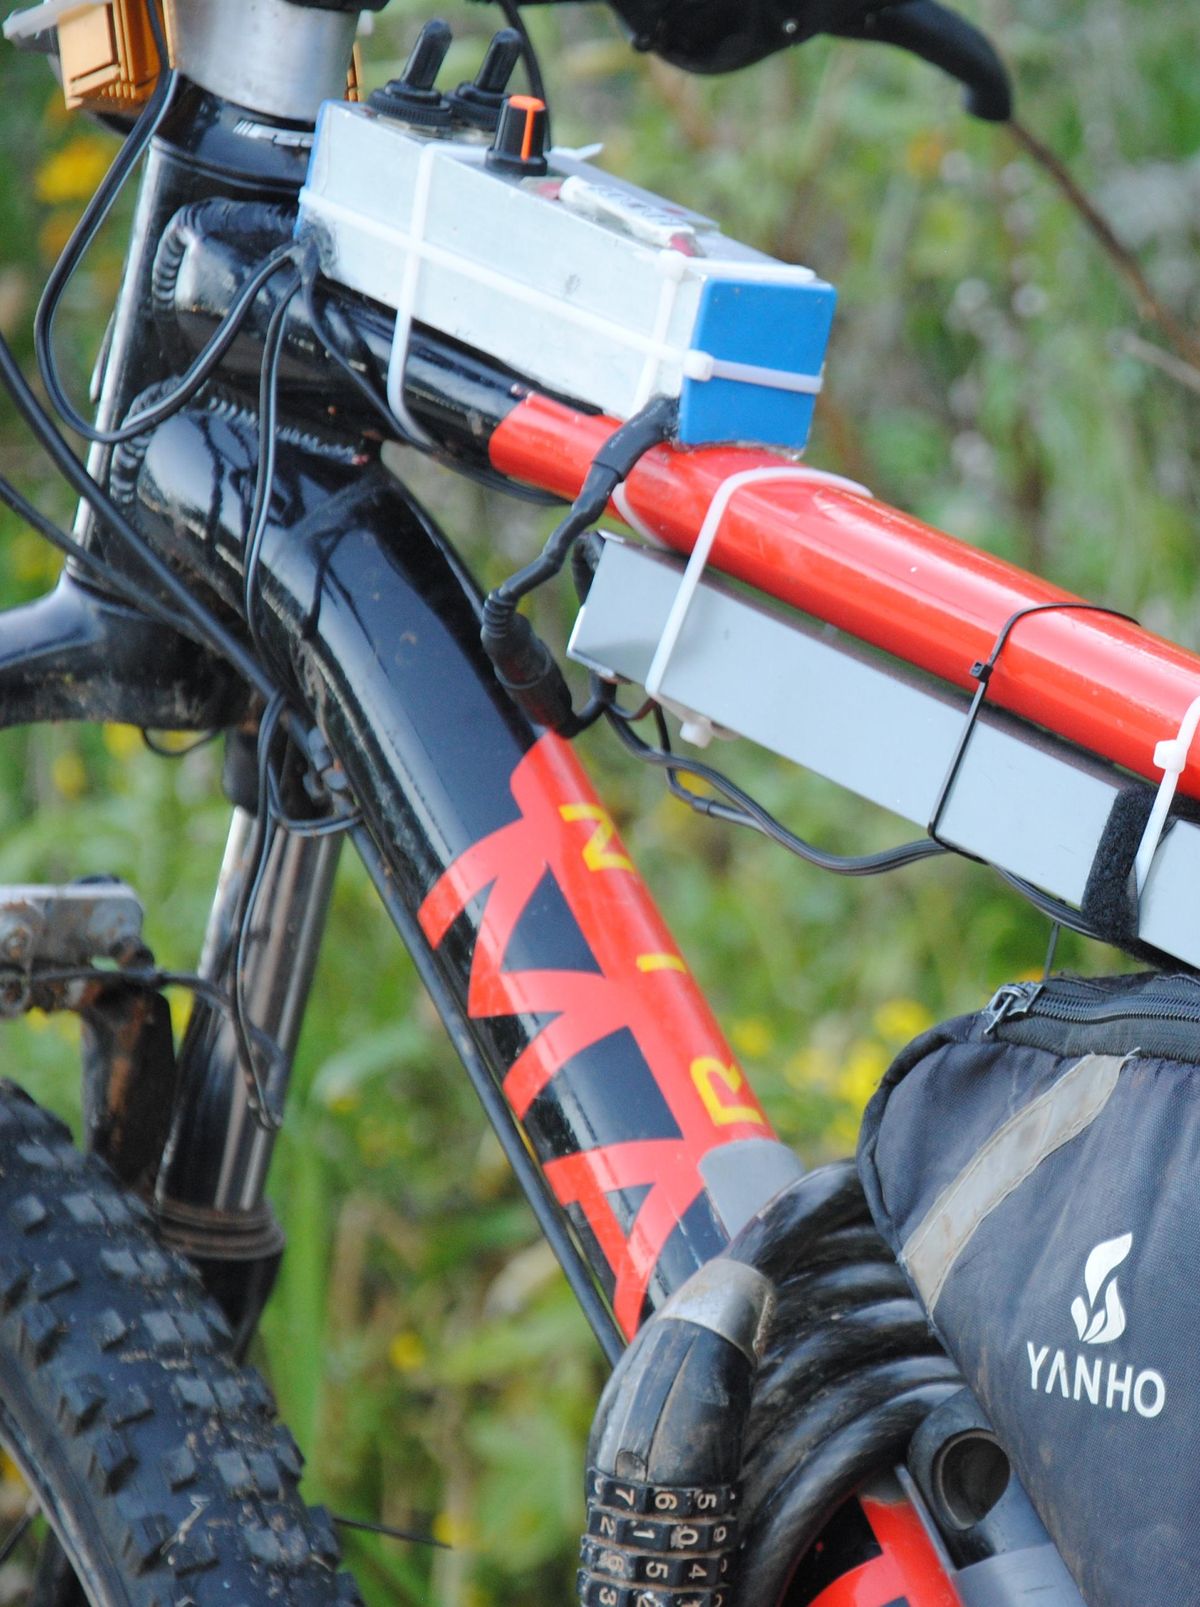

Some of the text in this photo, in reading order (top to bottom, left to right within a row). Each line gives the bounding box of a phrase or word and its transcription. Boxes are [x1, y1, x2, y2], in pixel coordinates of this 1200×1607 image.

[1026, 1341, 1166, 1418] YANHO
[655, 1492, 678, 1511] 6
[697, 1492, 718, 1510] 5
[645, 1560, 669, 1580] 5
[688, 1563, 708, 1580] 4
